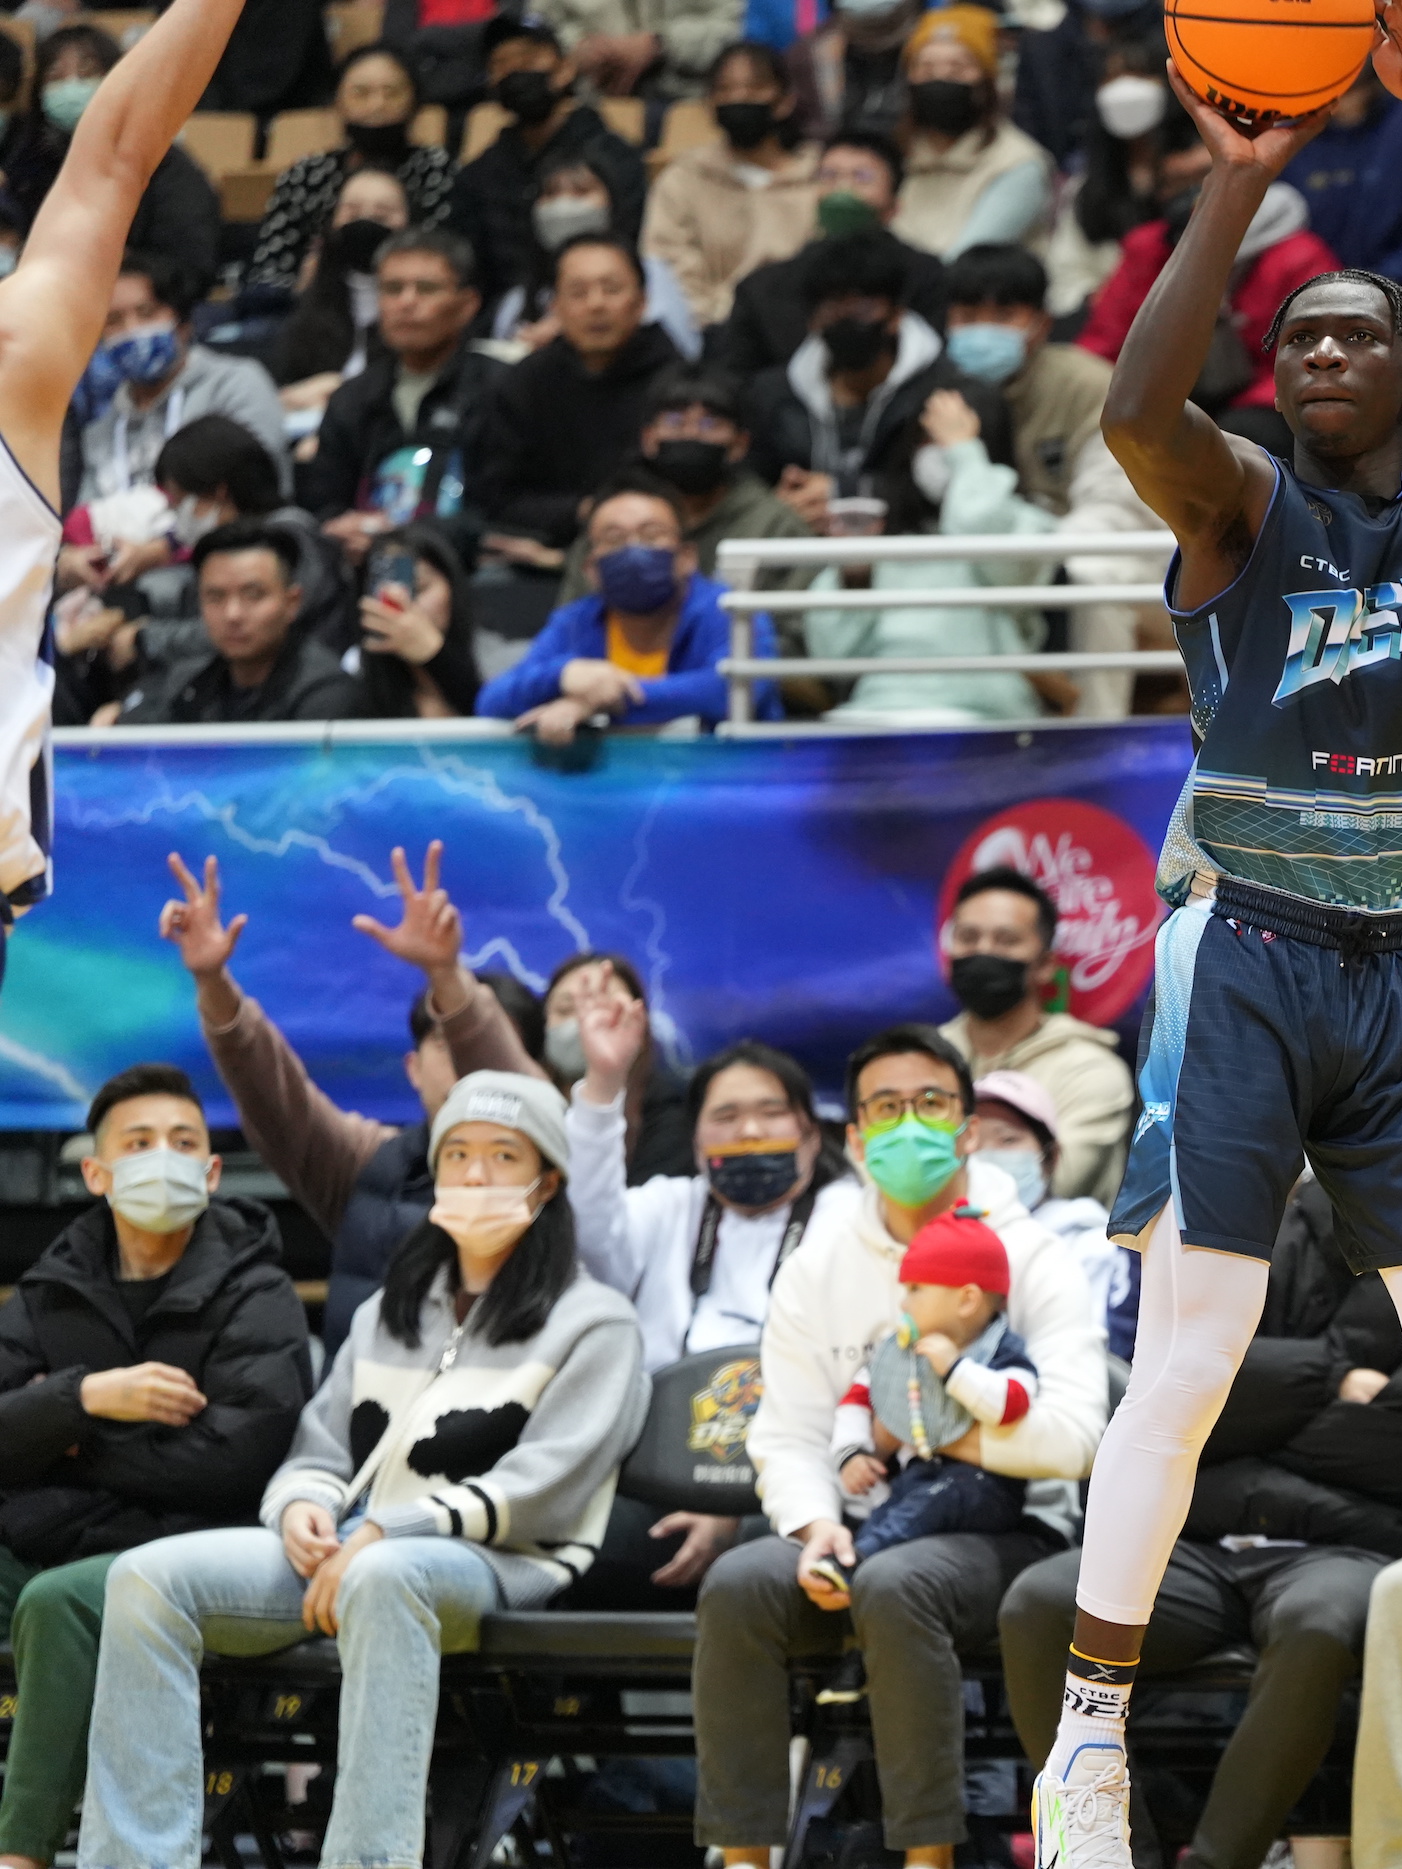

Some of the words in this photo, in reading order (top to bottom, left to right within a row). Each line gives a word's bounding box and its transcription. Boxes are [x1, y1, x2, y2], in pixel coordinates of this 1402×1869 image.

[1300, 554, 1350, 582] CTBC
[1079, 1686, 1121, 1701] CTBC
[273, 1694, 302, 1719] 19
[206, 1770, 234, 1796] 18
[510, 1762, 540, 1787] 17
[815, 1764, 843, 1790] 16
